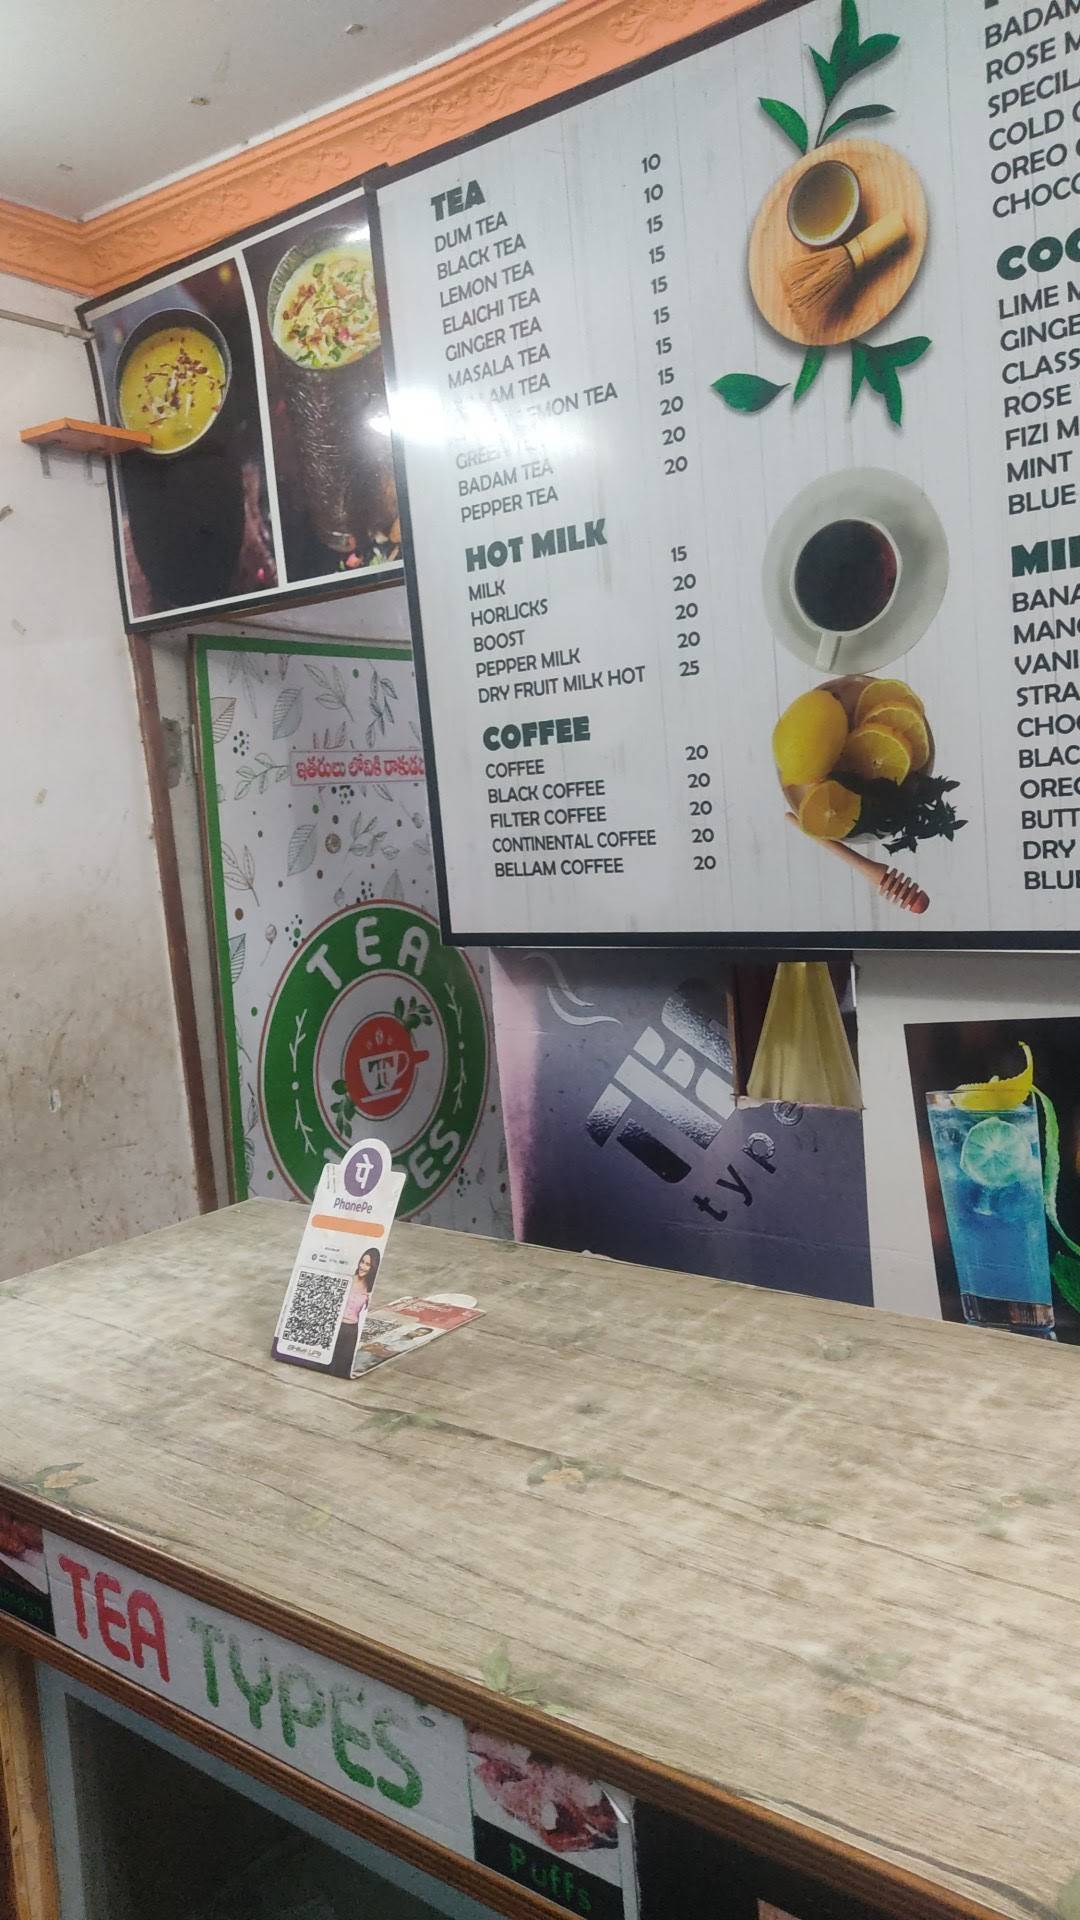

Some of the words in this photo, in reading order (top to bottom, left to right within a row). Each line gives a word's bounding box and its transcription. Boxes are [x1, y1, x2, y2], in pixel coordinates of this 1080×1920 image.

[986, 37, 1056, 84] ROSE
[988, 68, 1080, 118] SPECIL
[989, 108, 1064, 151] COLD
[641, 153, 661, 173] 10
[991, 143, 1067, 184] OREO
[430, 179, 486, 222] TEA
[644, 183, 664, 204] 10
[434, 224, 472, 253] DUM
[475, 211, 508, 236] TEA
[646, 214, 664, 234] 15
[437, 246, 490, 280] BLACK
[493, 233, 527, 258] TEA
[649, 245, 666, 264] 15
[439, 272, 498, 308] LEMON
[502, 260, 535, 285] TEA
[651, 276, 668, 294] 15
[442, 299, 505, 335] ELAICHI
[508, 287, 541, 312] TEA
[999, 285, 1060, 320] LIME
[653, 306, 671, 325] 15
[445, 328, 506, 362] GINGER
[509, 316, 542, 341] TEA
[655, 337, 673, 355] 15
[448, 355, 514, 389] MASALA
[518, 343, 551, 367] TEA
[658, 367, 675, 385] 15
[518, 372, 551, 396] TEA
[584, 382, 618, 406] TEA
[660, 395, 684, 416] 20
[1004, 384, 1072, 418] ROSE
[662, 426, 687, 446] 20
[1005, 422, 1049, 450] FIZI
[458, 467, 518, 497] BADAM
[521, 458, 554, 481] TEA
[664, 455, 689, 476] 20
[1007, 450, 1073, 483] MINT
[461, 494, 523, 523] PEPPER
[526, 485, 559, 507] TEA
[1008, 484, 1076, 515] BLUE
[465, 536, 524, 573] HOT
[531, 518, 608, 559] MILK
[671, 546, 688, 562] 15
[468, 579, 506, 601] MILK
[672, 573, 697, 592] 20
[471, 598, 549, 627] HORLICKS
[675, 602, 699, 620] 20
[473, 629, 525, 653] BOOST
[677, 631, 701, 649] 20
[1013, 616, 1080, 644] MAN
[476, 654, 537, 678] PEPPER
[541, 647, 581, 669] MILK
[679, 660, 700, 677] 25
[478, 685, 510, 704] DRY
[514, 677, 559, 699] FRUIT
[563, 672, 604, 693] MILK
[608, 665, 646, 686] HOT
[482, 716, 591, 751] COFFEE
[1017, 714, 1080, 738] CHO
[685, 744, 709, 761] 20
[485, 759, 545, 779] COFFEE
[687, 772, 711, 788] 20
[488, 785, 539, 804] BLACK
[543, 779, 606, 800] COFFEE
[490, 811, 540, 828] FILTER
[544, 806, 607, 825] COFFEE
[689, 800, 713, 816] 20
[492, 833, 594, 853] CONTINENTAL
[597, 829, 657, 848] COFFEE
[691, 828, 715, 844] 20
[1023, 839, 1076, 860] DRY
[494, 860, 557, 878] BELLAM
[561, 857, 624, 876] COFFEE
[693, 855, 717, 871] 20
[305, 916, 430, 990] TEA
[333, 1197, 373, 1215] PhonePe
[58, 1553, 171, 1683] TEA
[187, 1616, 423, 1809] TYPES
